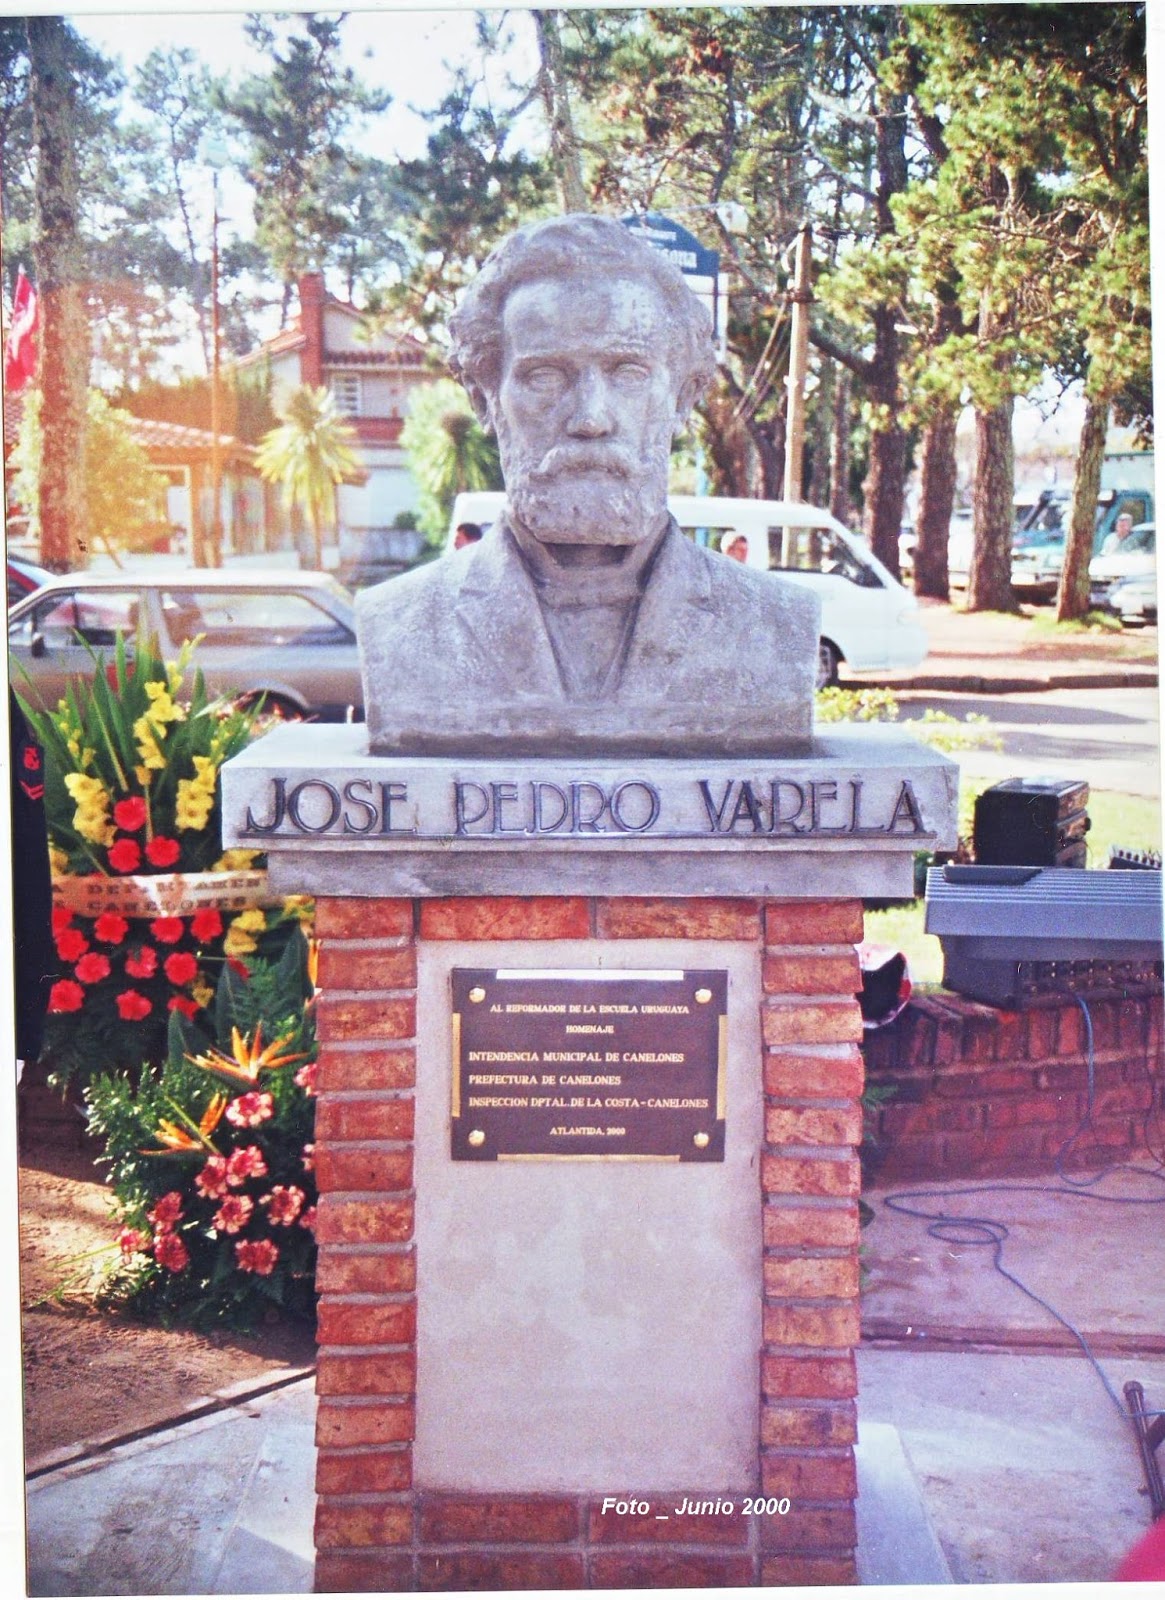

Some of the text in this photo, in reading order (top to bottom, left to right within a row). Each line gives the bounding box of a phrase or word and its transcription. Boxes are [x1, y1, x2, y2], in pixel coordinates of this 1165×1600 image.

[247, 777, 927, 834] JOSE PEDRO VARELA
[490, 1004, 690, 1014] AL REFORMADOR DE LA ESCUELA URUGUAYA
[566, 1025, 615, 1034] HOMENAJE
[469, 1051, 685, 1063] INTENDENCIA MUNICIPAL DE CANELONES
[469, 1074, 621, 1086] PREFECTURA DE CANELONES
[469, 1097, 528, 1108] INSPECCION
[586, 1098, 603, 1108] LA
[606, 1127, 626, 1136] 2000
